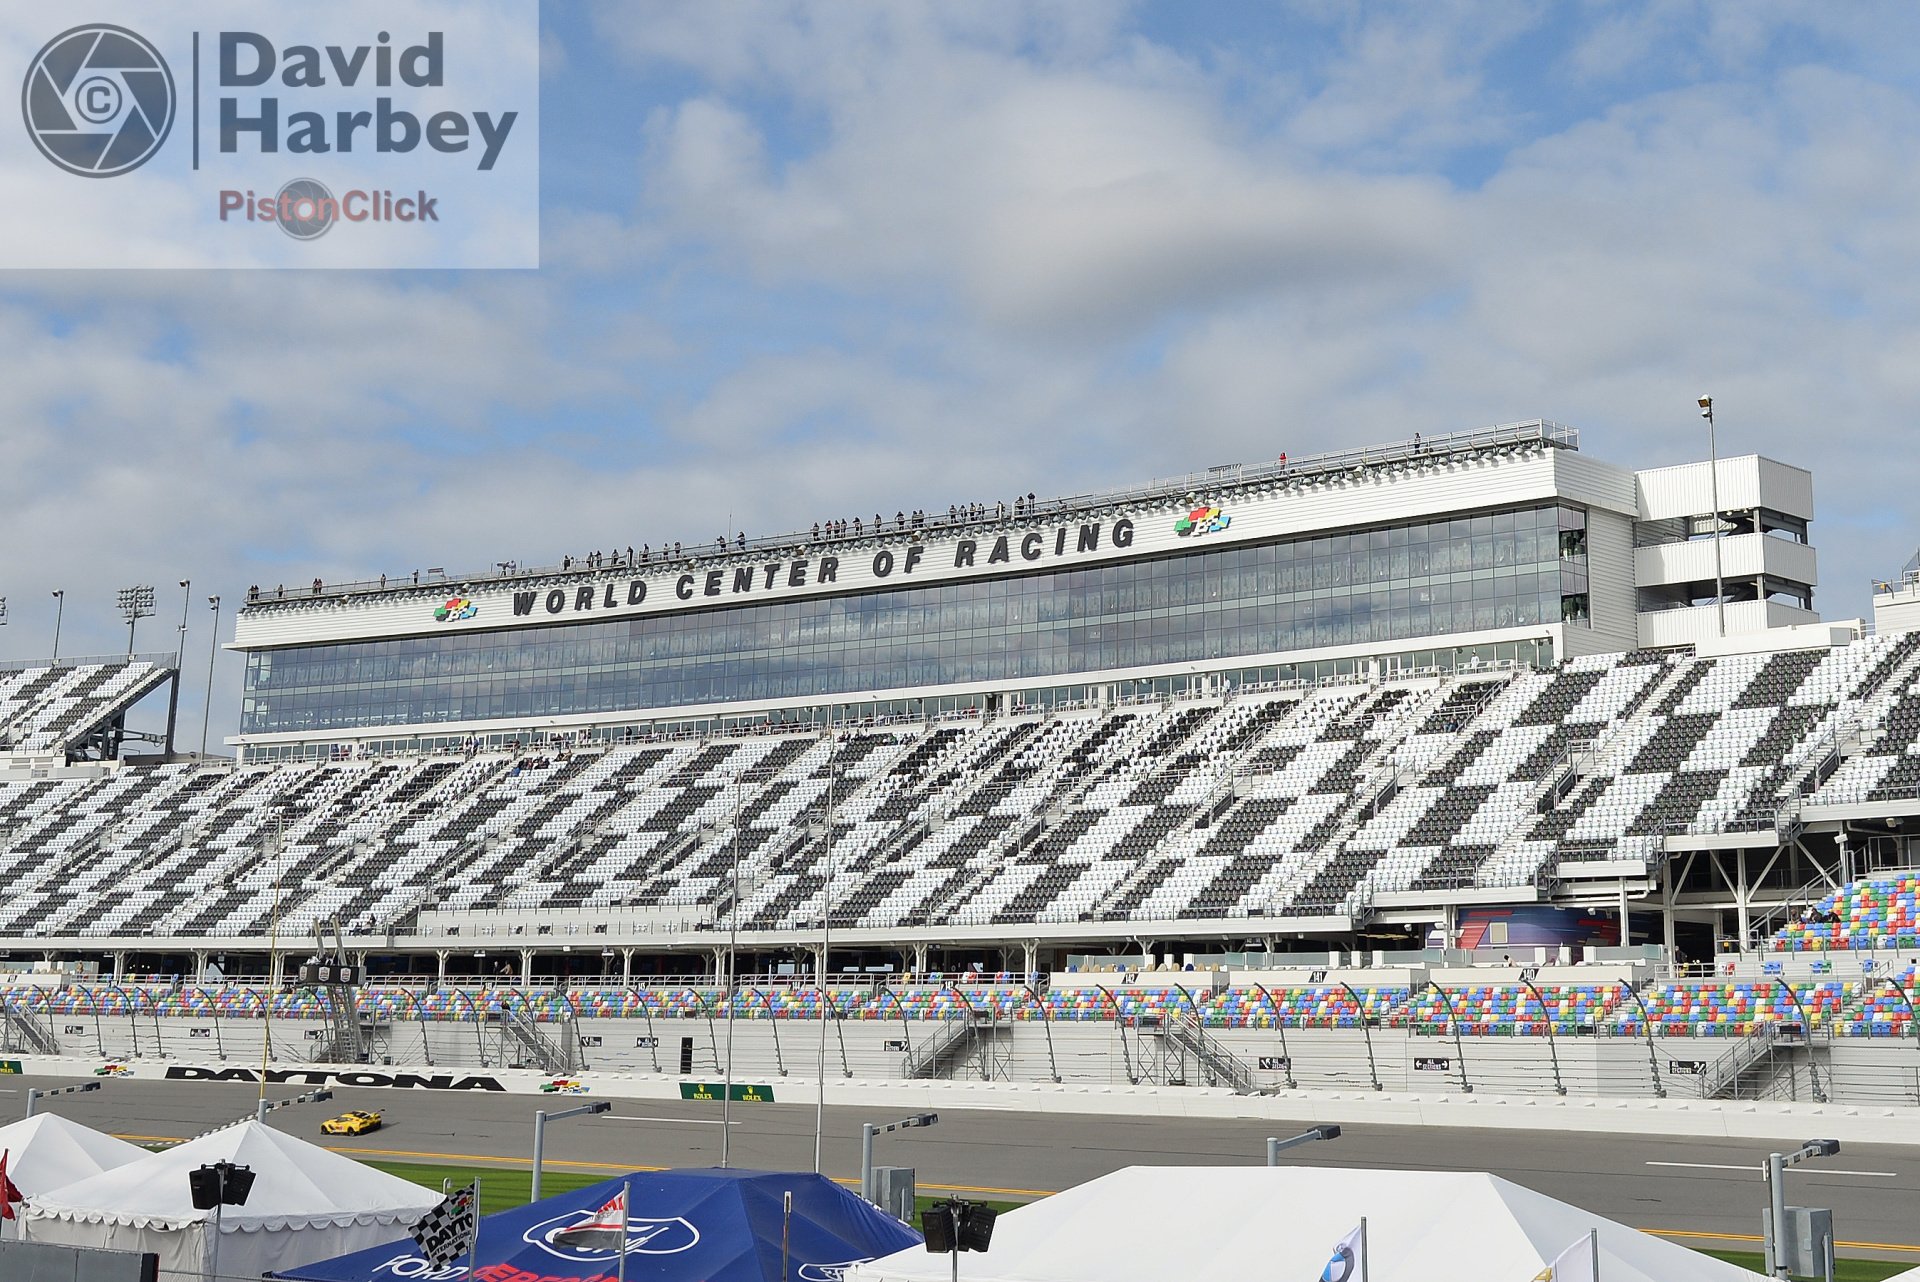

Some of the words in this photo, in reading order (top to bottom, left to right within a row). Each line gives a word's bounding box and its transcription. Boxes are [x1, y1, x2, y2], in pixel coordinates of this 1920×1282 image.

[513, 579, 647, 616] WORLD
[675, 556, 839, 600] CENTER
[871, 546, 925, 578] OF
[953, 519, 1134, 568] RACING
[165, 1066, 507, 1091] DAYTONA
[426, 1213, 473, 1252] DAYTO
[371, 1253, 470, 1281] FORD
